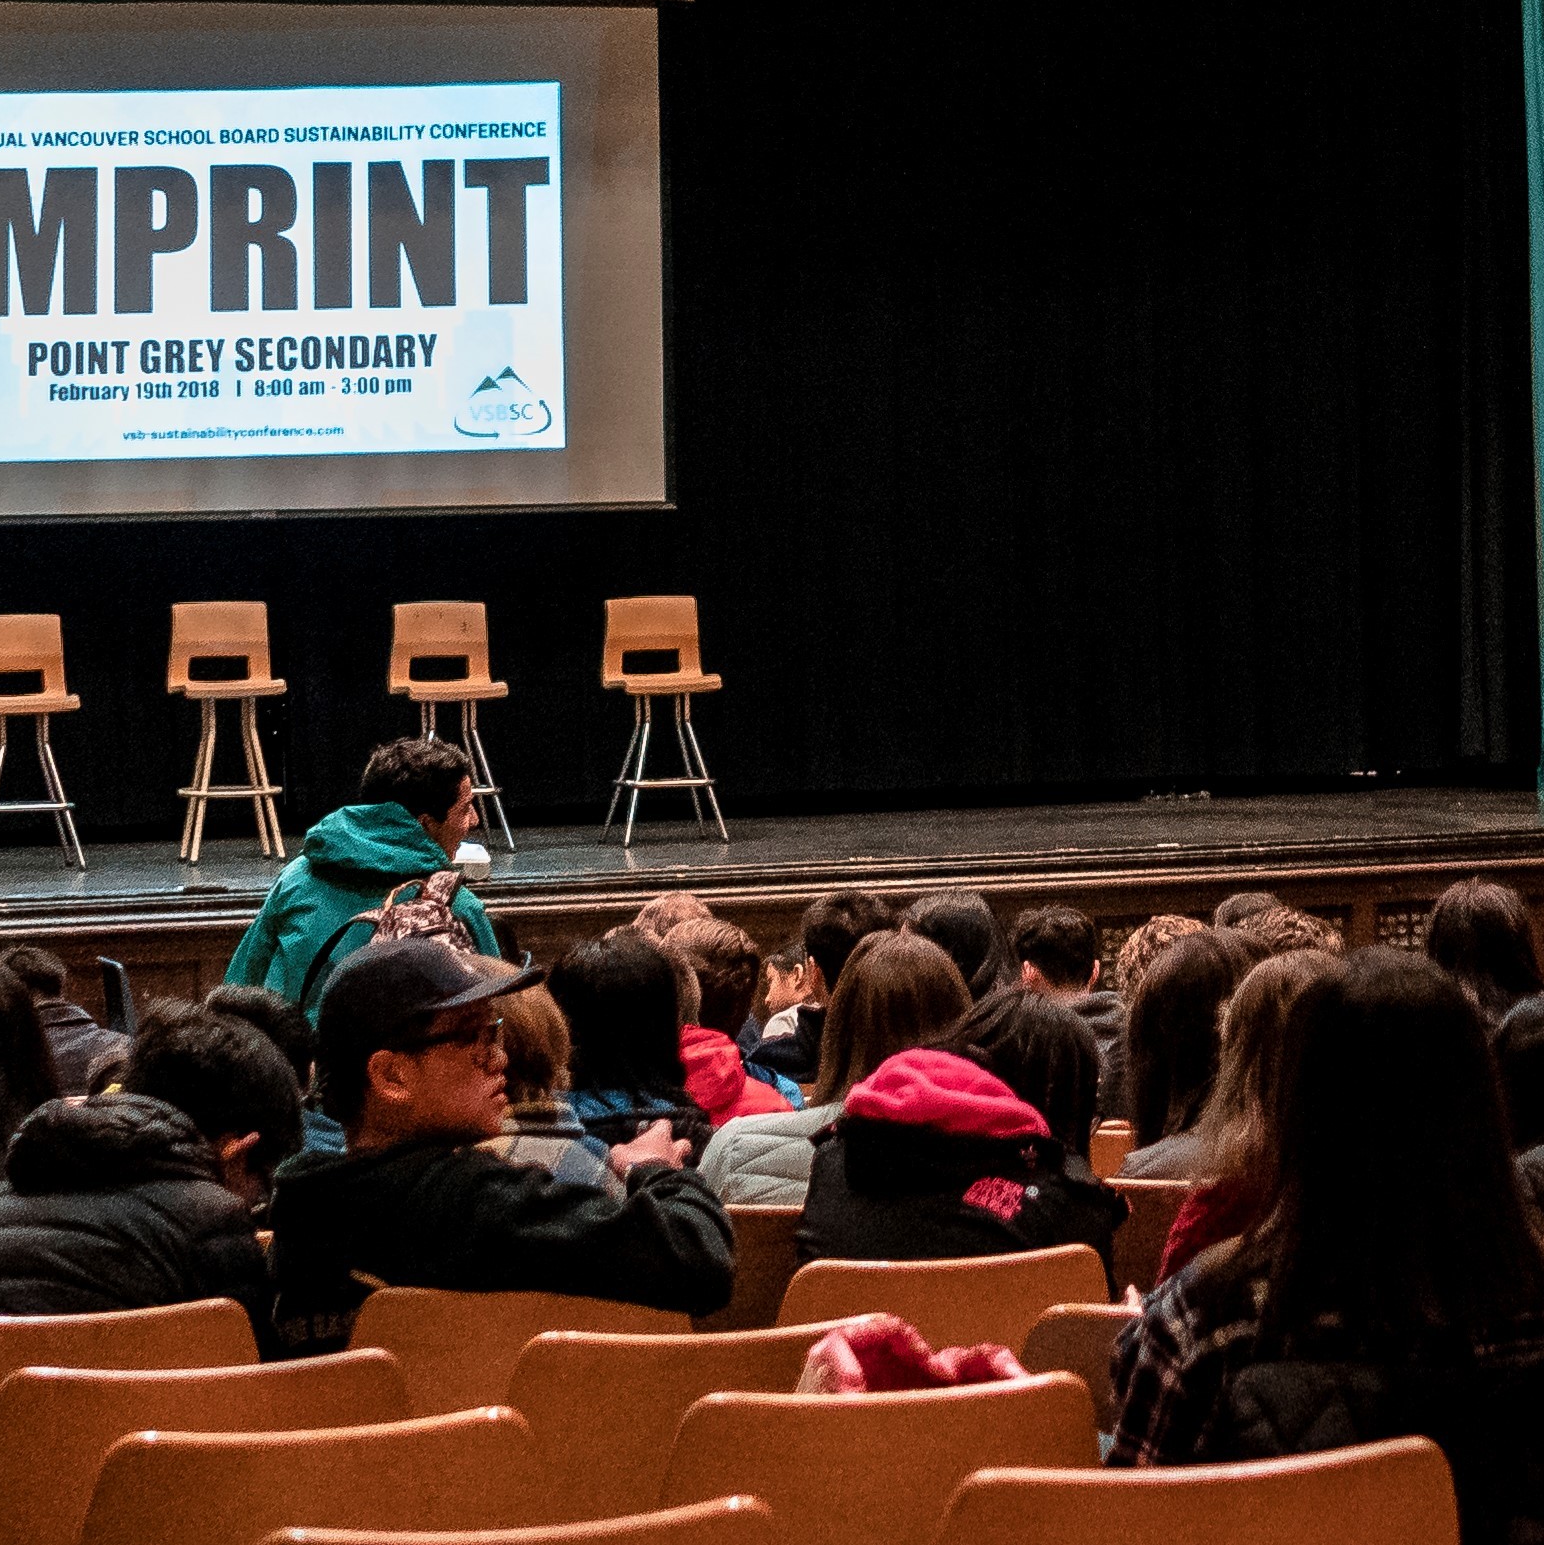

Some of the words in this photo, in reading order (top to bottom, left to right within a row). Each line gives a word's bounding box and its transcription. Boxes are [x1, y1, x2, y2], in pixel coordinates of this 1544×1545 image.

[31, 130, 139, 147] VANCOUVER
[143, 129, 214, 146] SCHOOL
[219, 128, 279, 144] BOARD
[284, 125, 426, 143] SUSTAINABILITY
[429, 121, 547, 139] CONFERENCE
[28, 340, 130, 376] POINT
[139, 339, 225, 374] GREY
[234, 333, 437, 372] SECONDARY
[49, 383, 129, 401] February
[135, 381, 172, 399] 19th
[177, 380, 219, 398] 2018
[255, 378, 293, 397] 8:00
[298, 380, 325, 395] am
[341, 377, 379, 395] 3:00
[385, 378, 412, 395] pm
